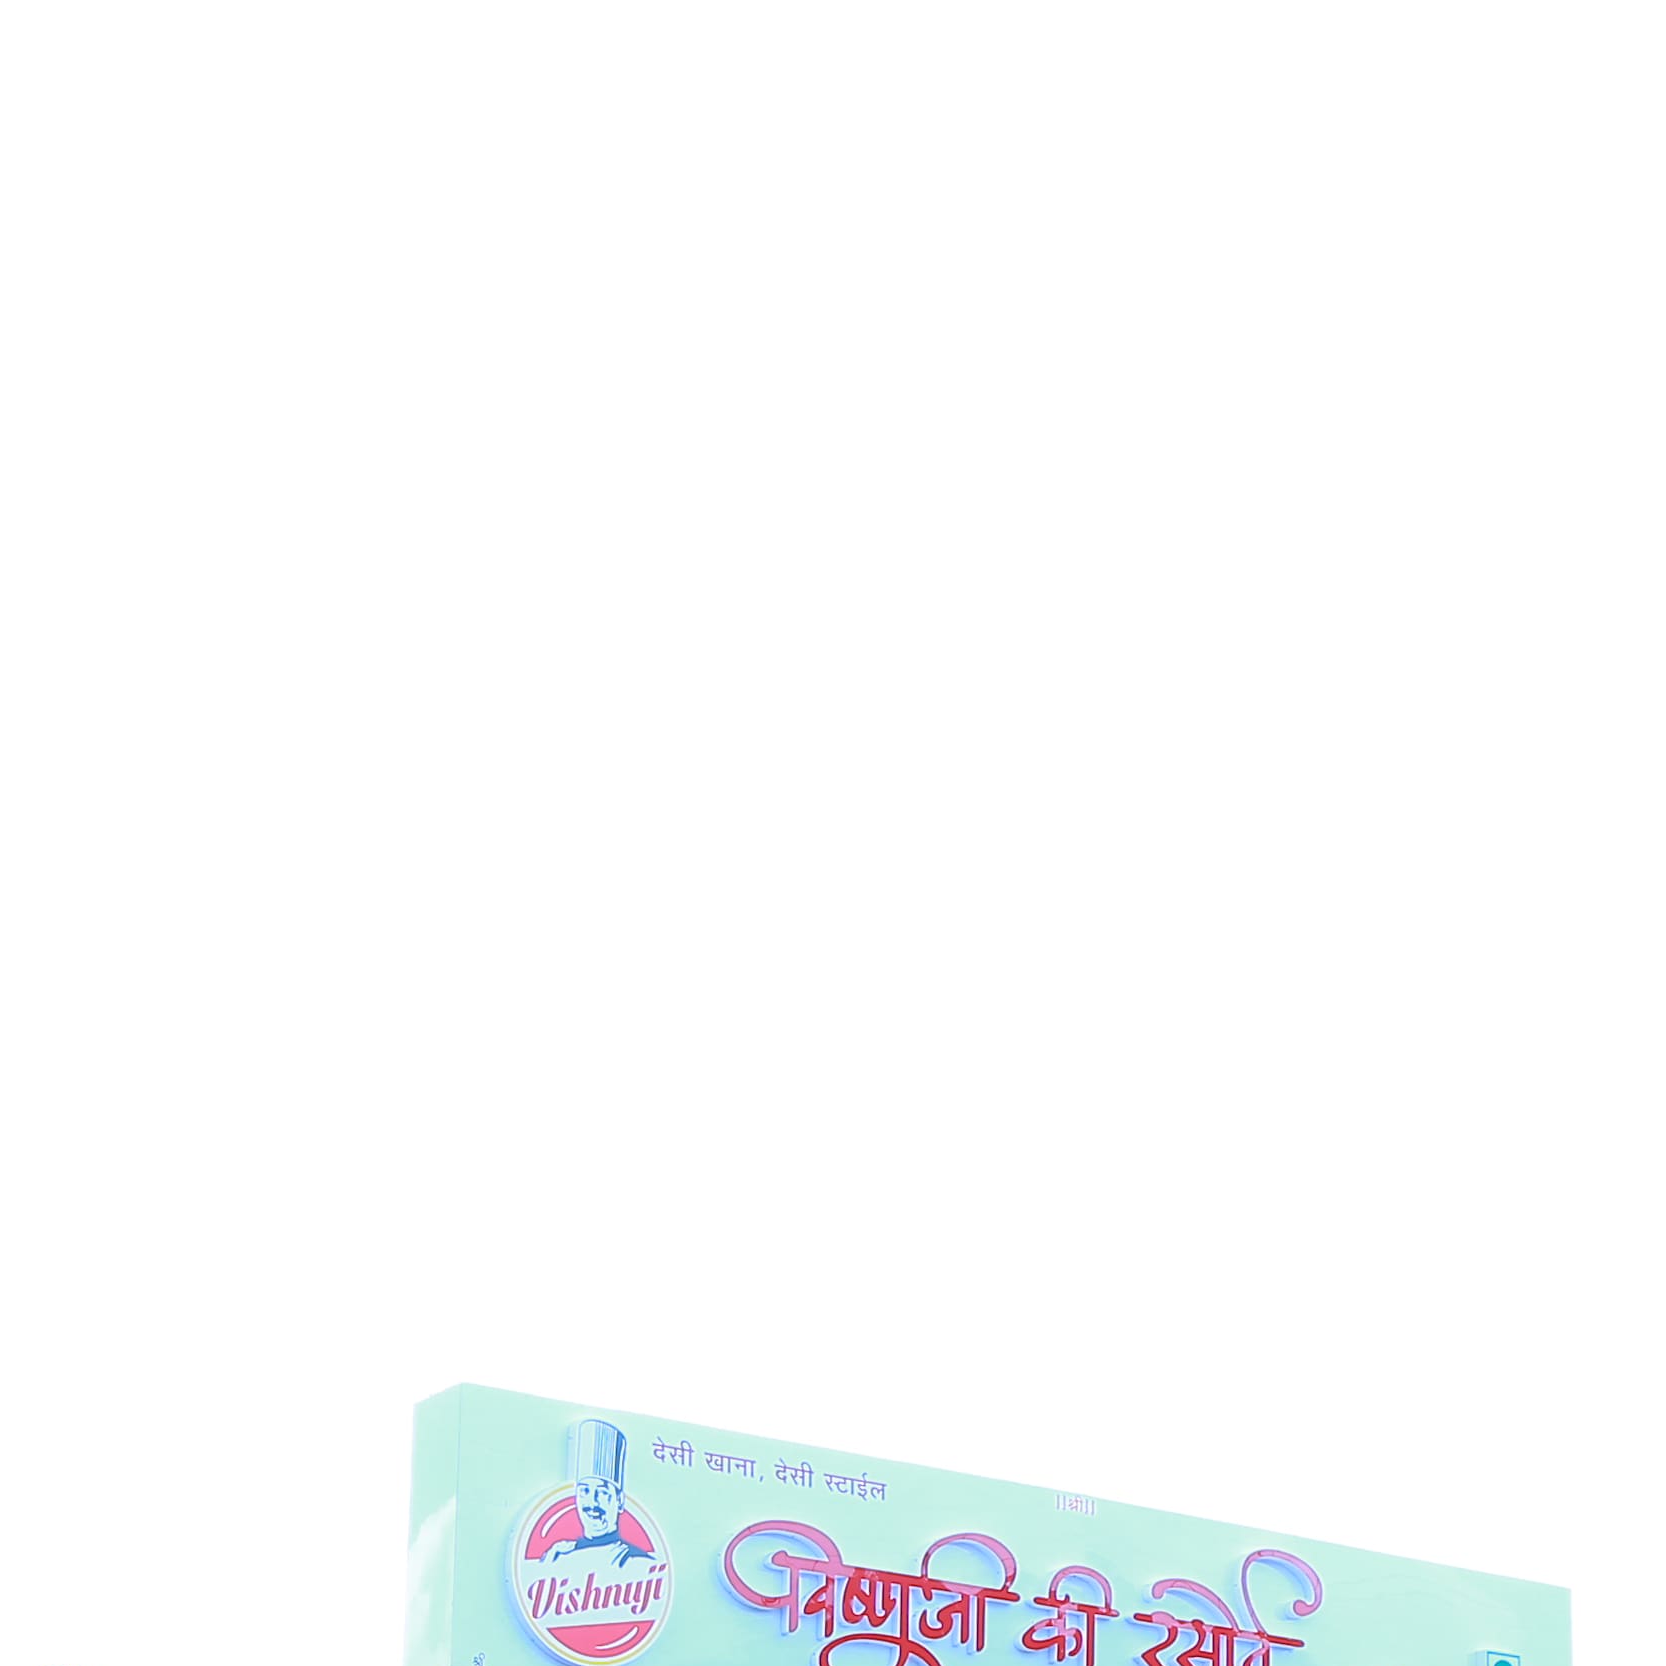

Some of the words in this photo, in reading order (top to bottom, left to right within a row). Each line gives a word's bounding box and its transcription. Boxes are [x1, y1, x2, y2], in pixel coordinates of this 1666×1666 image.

[652, 1436, 694, 1467] देसी
[774, 1457, 814, 1488] देसी
[824, 1472, 887, 1501] स्टाईल
[527, 1563, 667, 1619] Vishnuji
